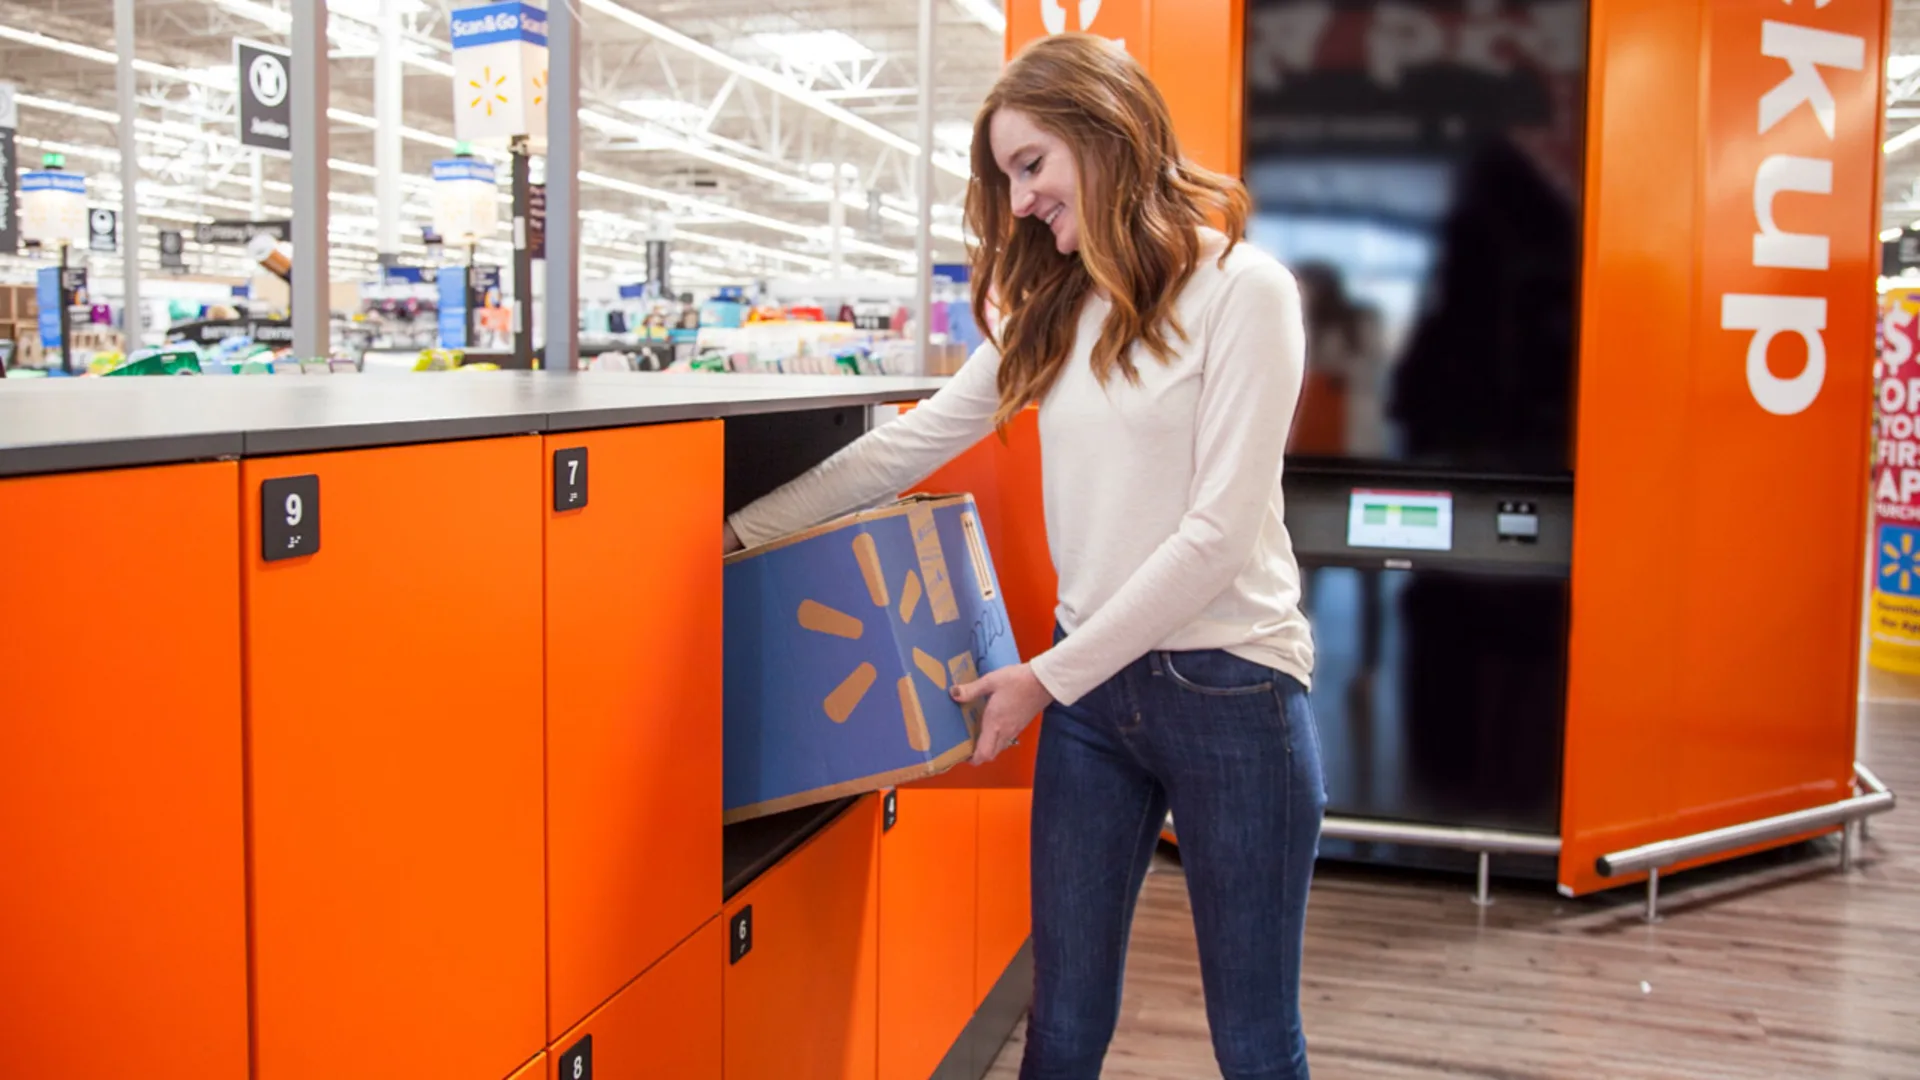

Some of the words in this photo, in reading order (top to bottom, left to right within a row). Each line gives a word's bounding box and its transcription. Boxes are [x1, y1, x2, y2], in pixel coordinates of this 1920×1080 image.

[1721, 0, 1866, 416] kup
[567, 460, 579, 485] 7
[285, 493, 303, 526] 9
[888, 797, 895, 812] 4
[738, 920, 747, 939] 6
[573, 1055, 582, 1079] 8
